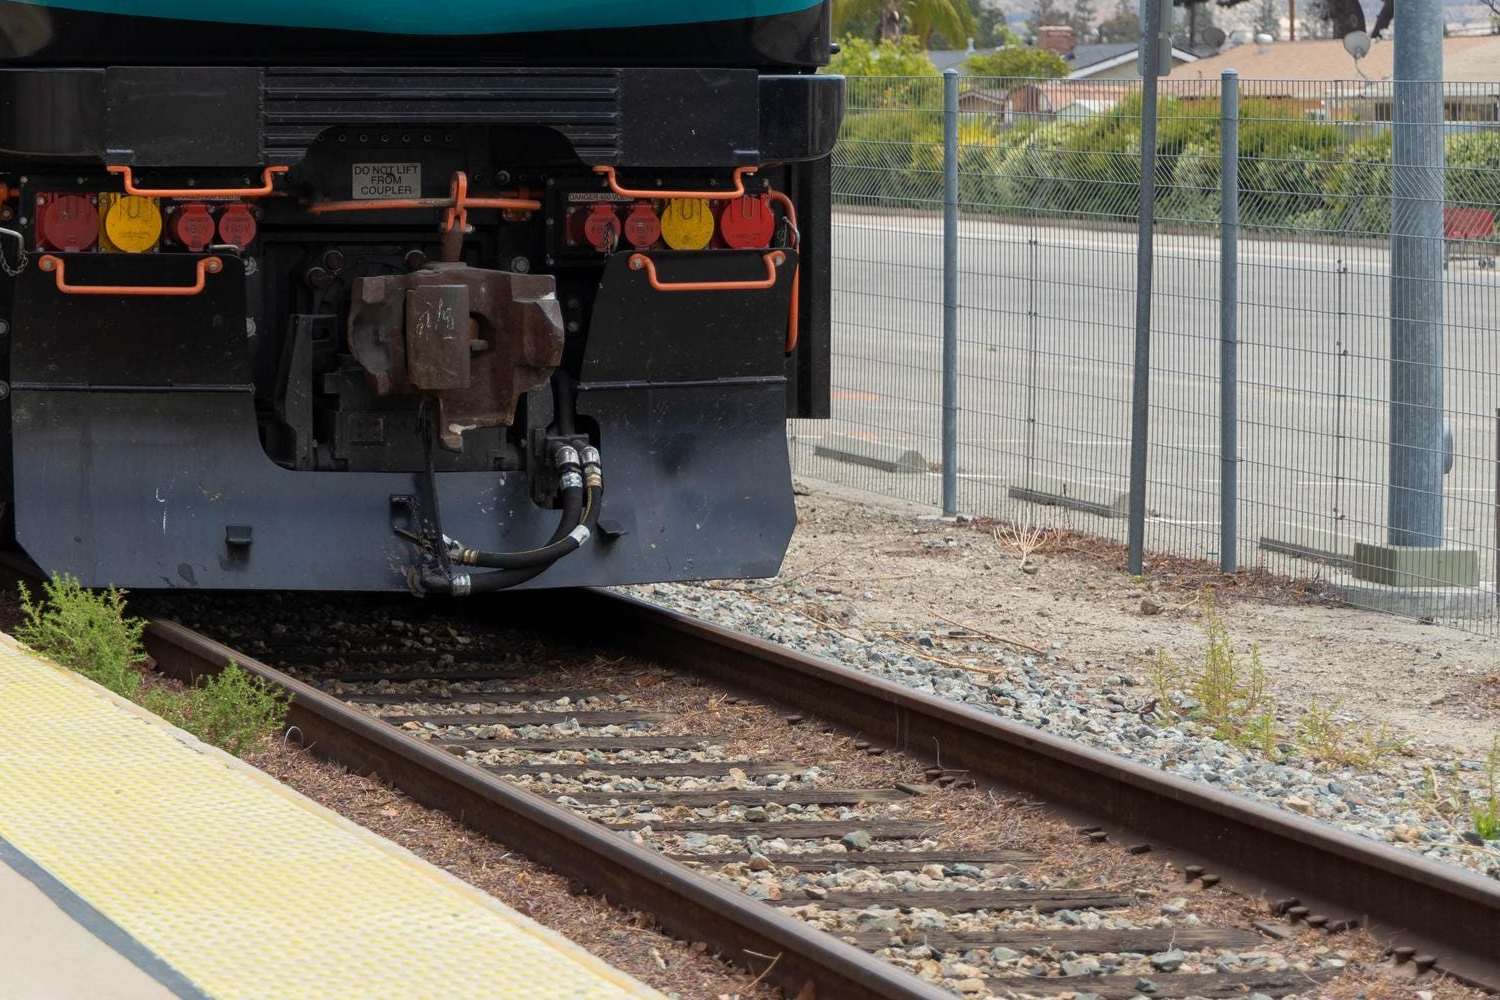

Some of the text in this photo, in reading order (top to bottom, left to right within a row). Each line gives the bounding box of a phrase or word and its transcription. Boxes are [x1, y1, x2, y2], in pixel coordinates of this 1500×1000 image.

[354, 165, 420, 175] DO NOT LIFT
[371, 175, 402, 185] FROM
[360, 185, 412, 195] COUPLER
